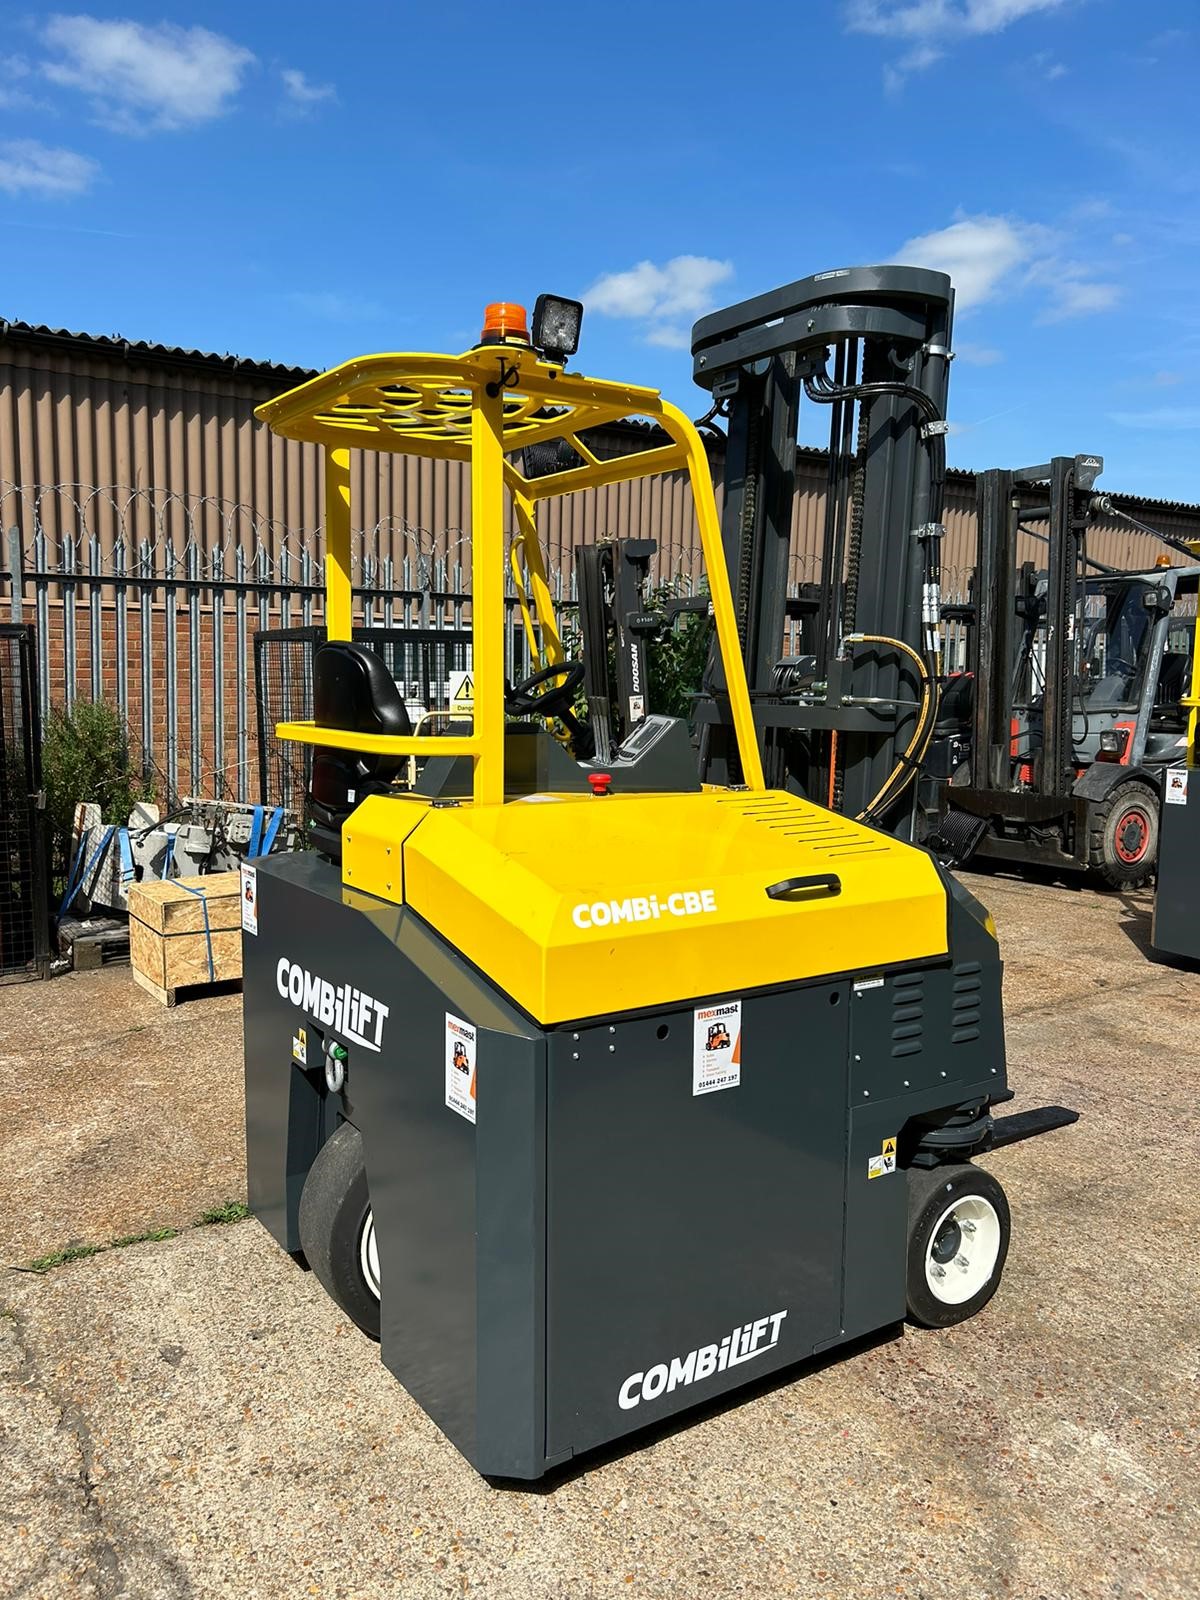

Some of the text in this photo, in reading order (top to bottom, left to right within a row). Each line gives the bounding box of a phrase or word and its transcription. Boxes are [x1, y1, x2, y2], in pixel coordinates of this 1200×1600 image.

[631, 643, 640, 692] DOOSAN
[698, 1004, 738, 1019] mexmast
[698, 1079, 716, 1088] 01444
